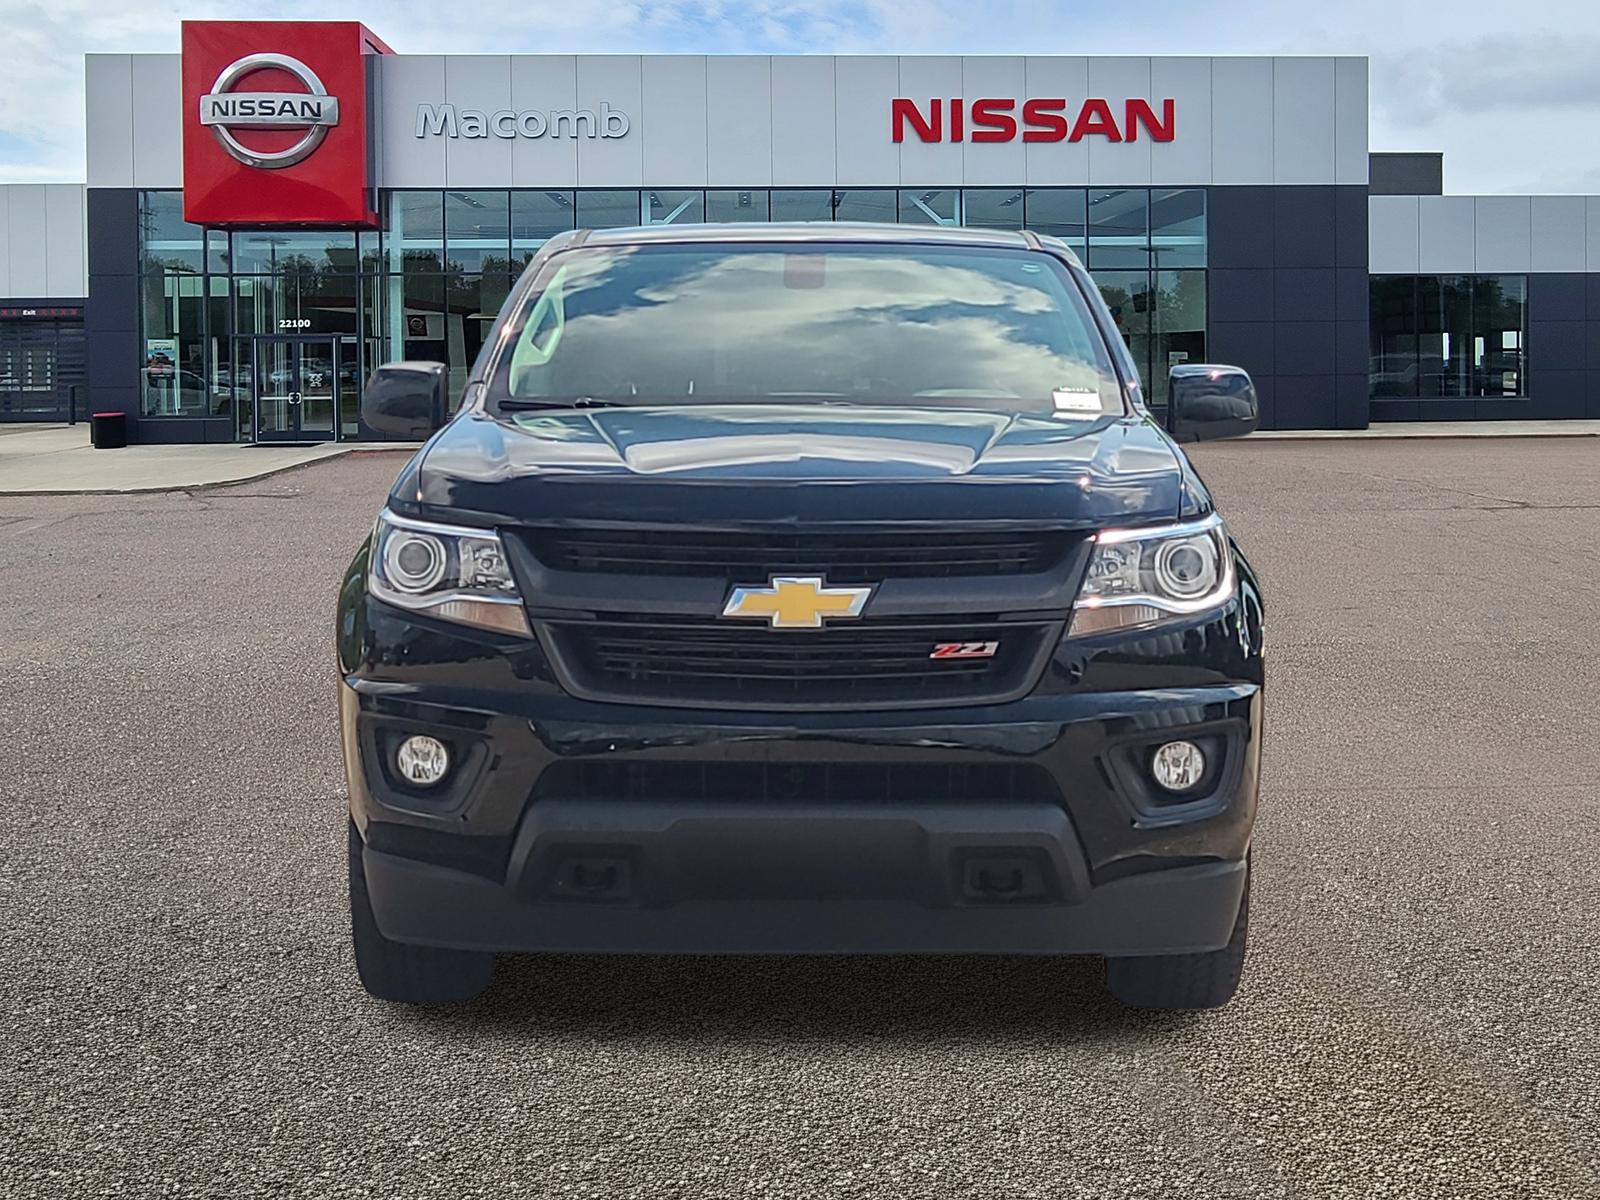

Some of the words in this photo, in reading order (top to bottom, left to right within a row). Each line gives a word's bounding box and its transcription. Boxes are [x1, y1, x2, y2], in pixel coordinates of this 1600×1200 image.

[212, 100, 322, 118] NISSAN
[415, 101, 630, 138] Macomb
[892, 98, 1175, 142] NISSAN
[279, 319, 311, 328] 22100
